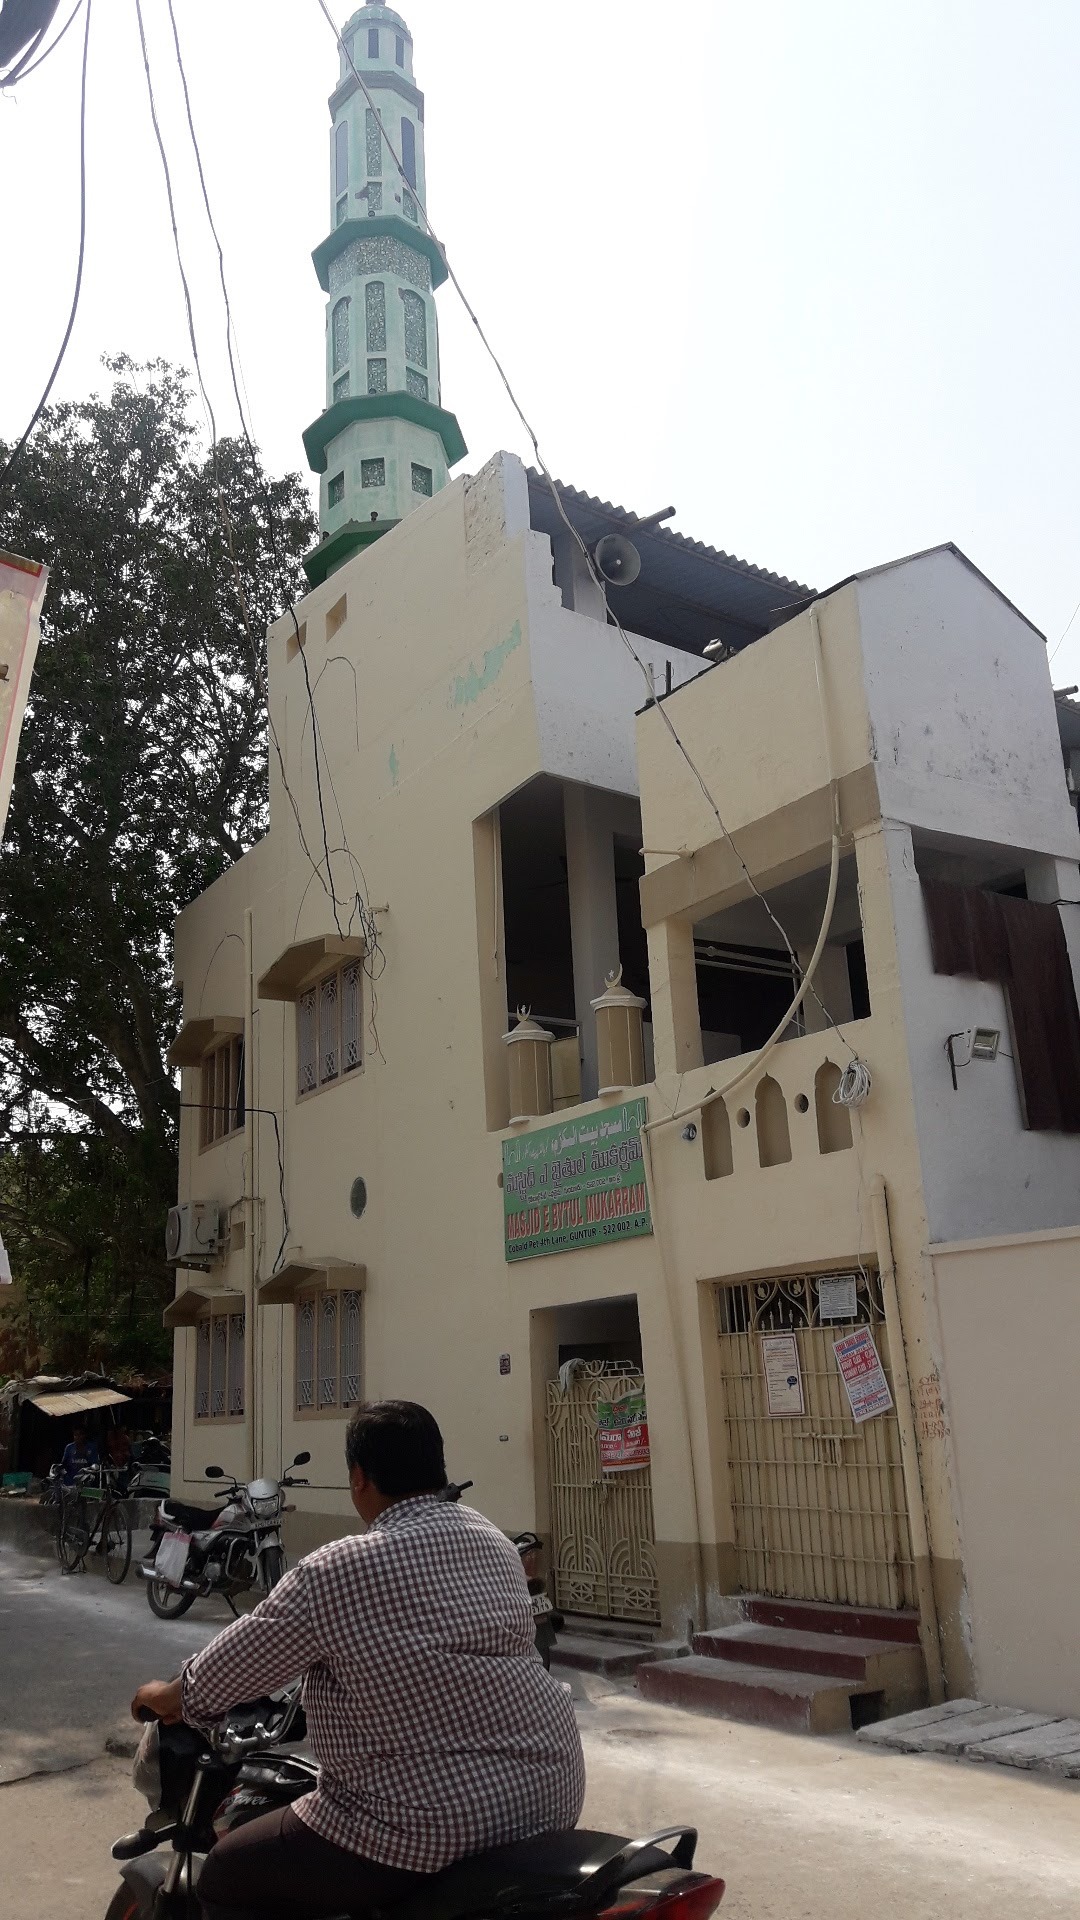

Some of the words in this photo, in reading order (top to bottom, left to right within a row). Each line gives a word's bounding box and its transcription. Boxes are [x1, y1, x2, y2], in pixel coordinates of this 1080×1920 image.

[508, 1206, 541, 1240] MASJID
[544, 1204, 550, 1233] E
[552, 1198, 584, 1232] BYTUL
[586, 1182, 647, 1224] MUKARRAM
[569, 1228, 597, 1241] GUNTUR
[602, 1222, 616, 1235] 522
